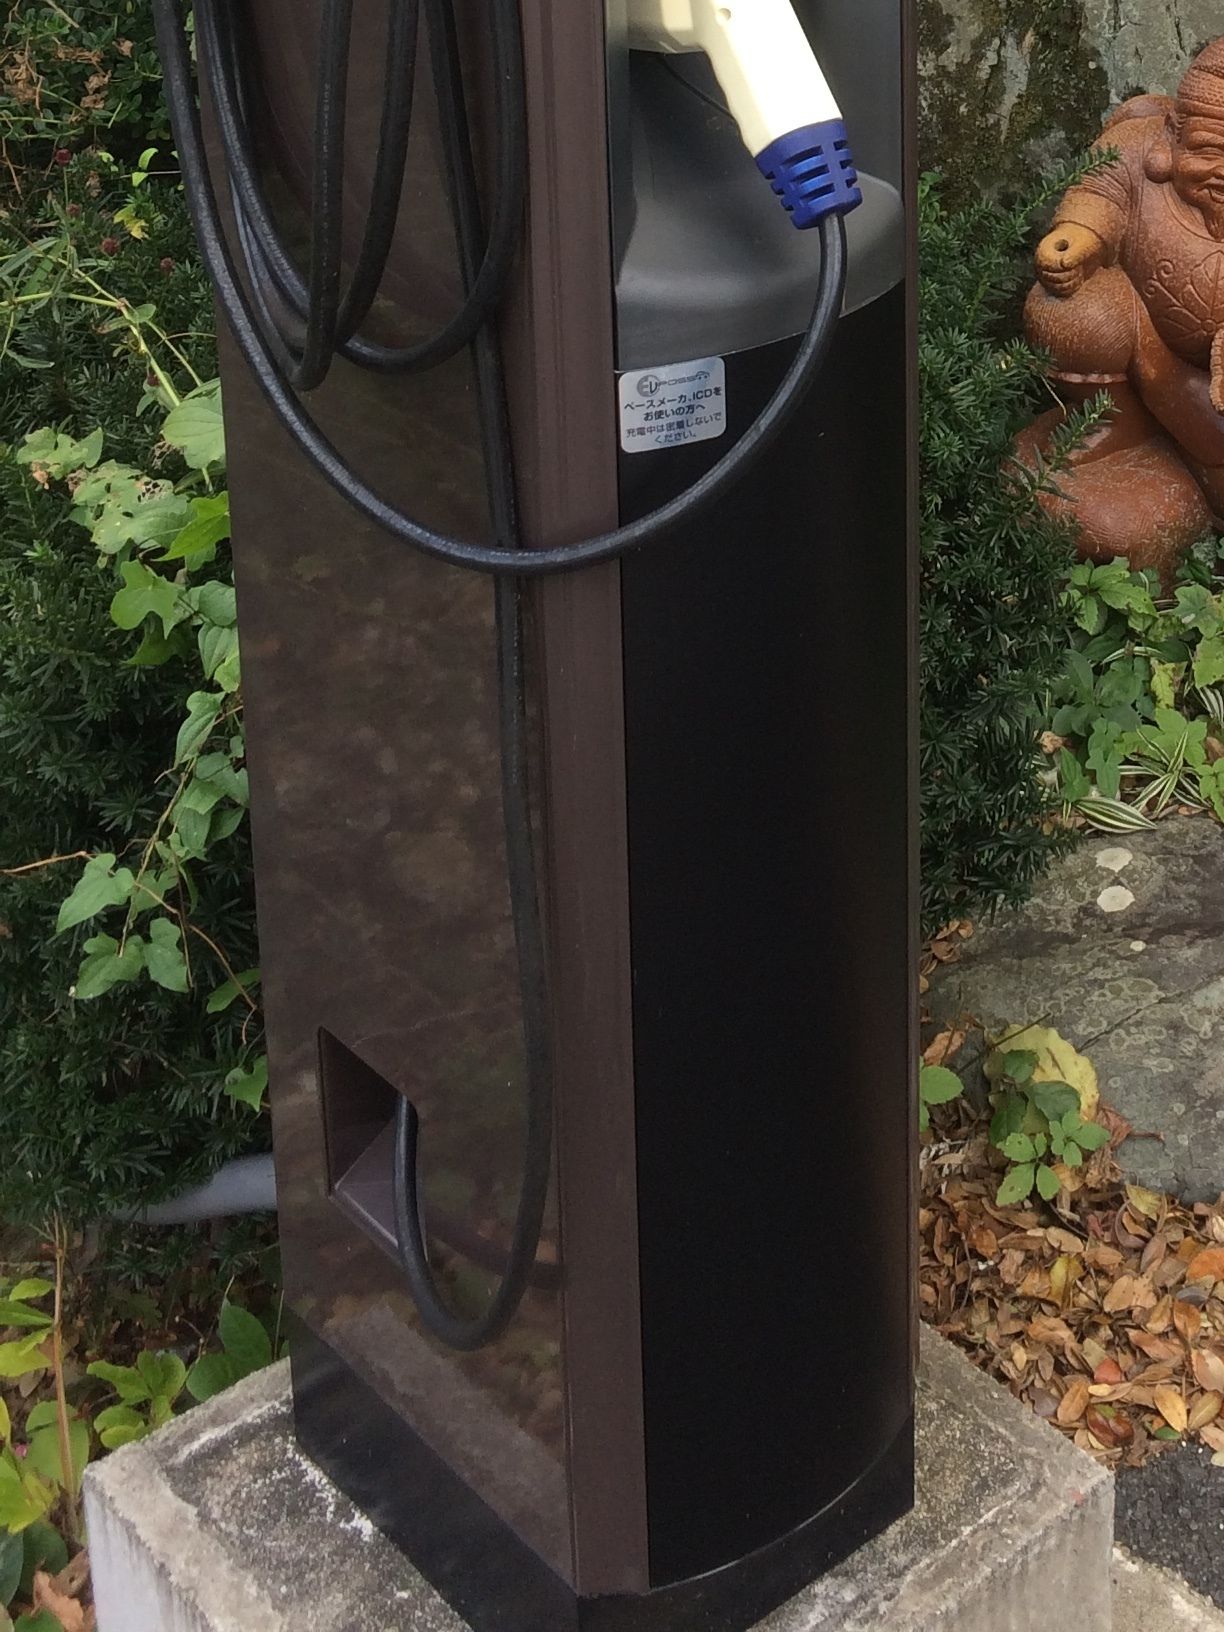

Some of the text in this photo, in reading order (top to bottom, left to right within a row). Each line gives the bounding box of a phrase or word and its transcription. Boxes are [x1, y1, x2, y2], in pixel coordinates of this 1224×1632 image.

[644, 403, 706, 422] お使いの方へ
